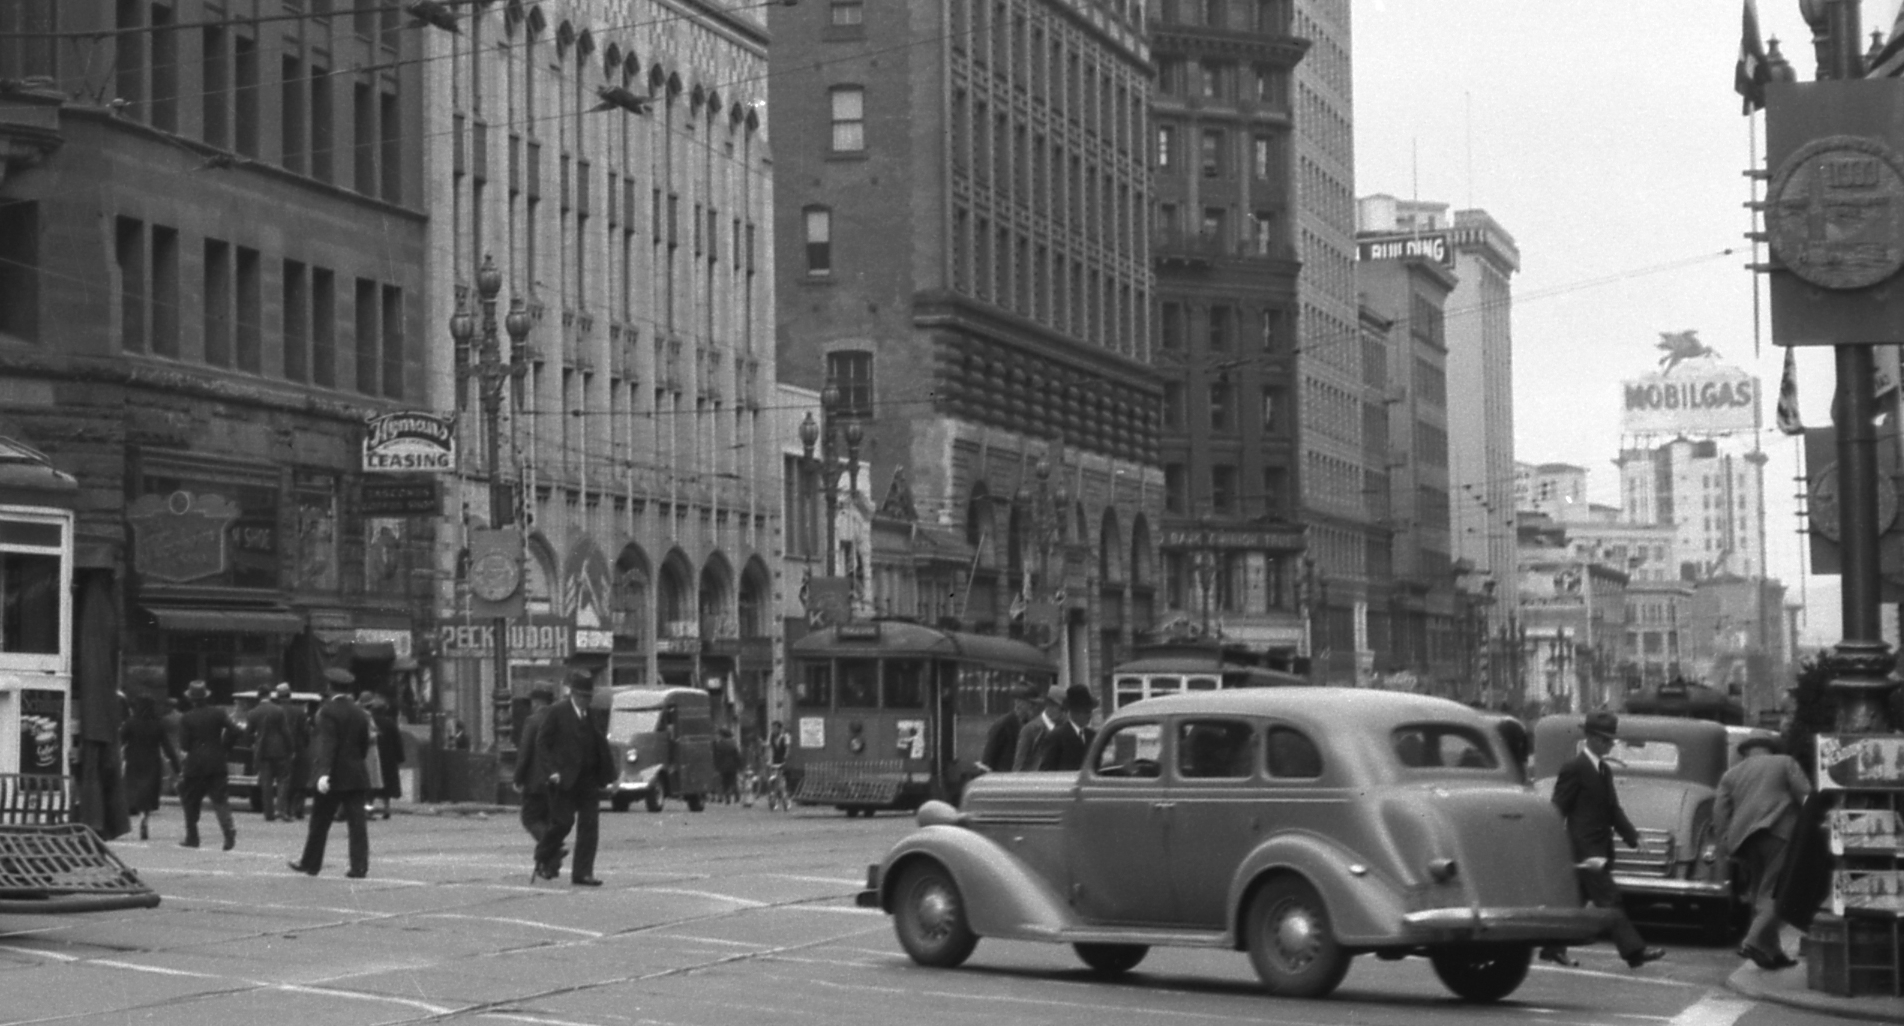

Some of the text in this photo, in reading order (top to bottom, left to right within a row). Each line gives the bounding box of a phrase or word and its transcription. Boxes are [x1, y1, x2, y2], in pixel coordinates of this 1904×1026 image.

[1625, 381, 1752, 411] MOBILGAS
[367, 452, 449, 468] LEASING
[441, 626, 496, 652] PECK
